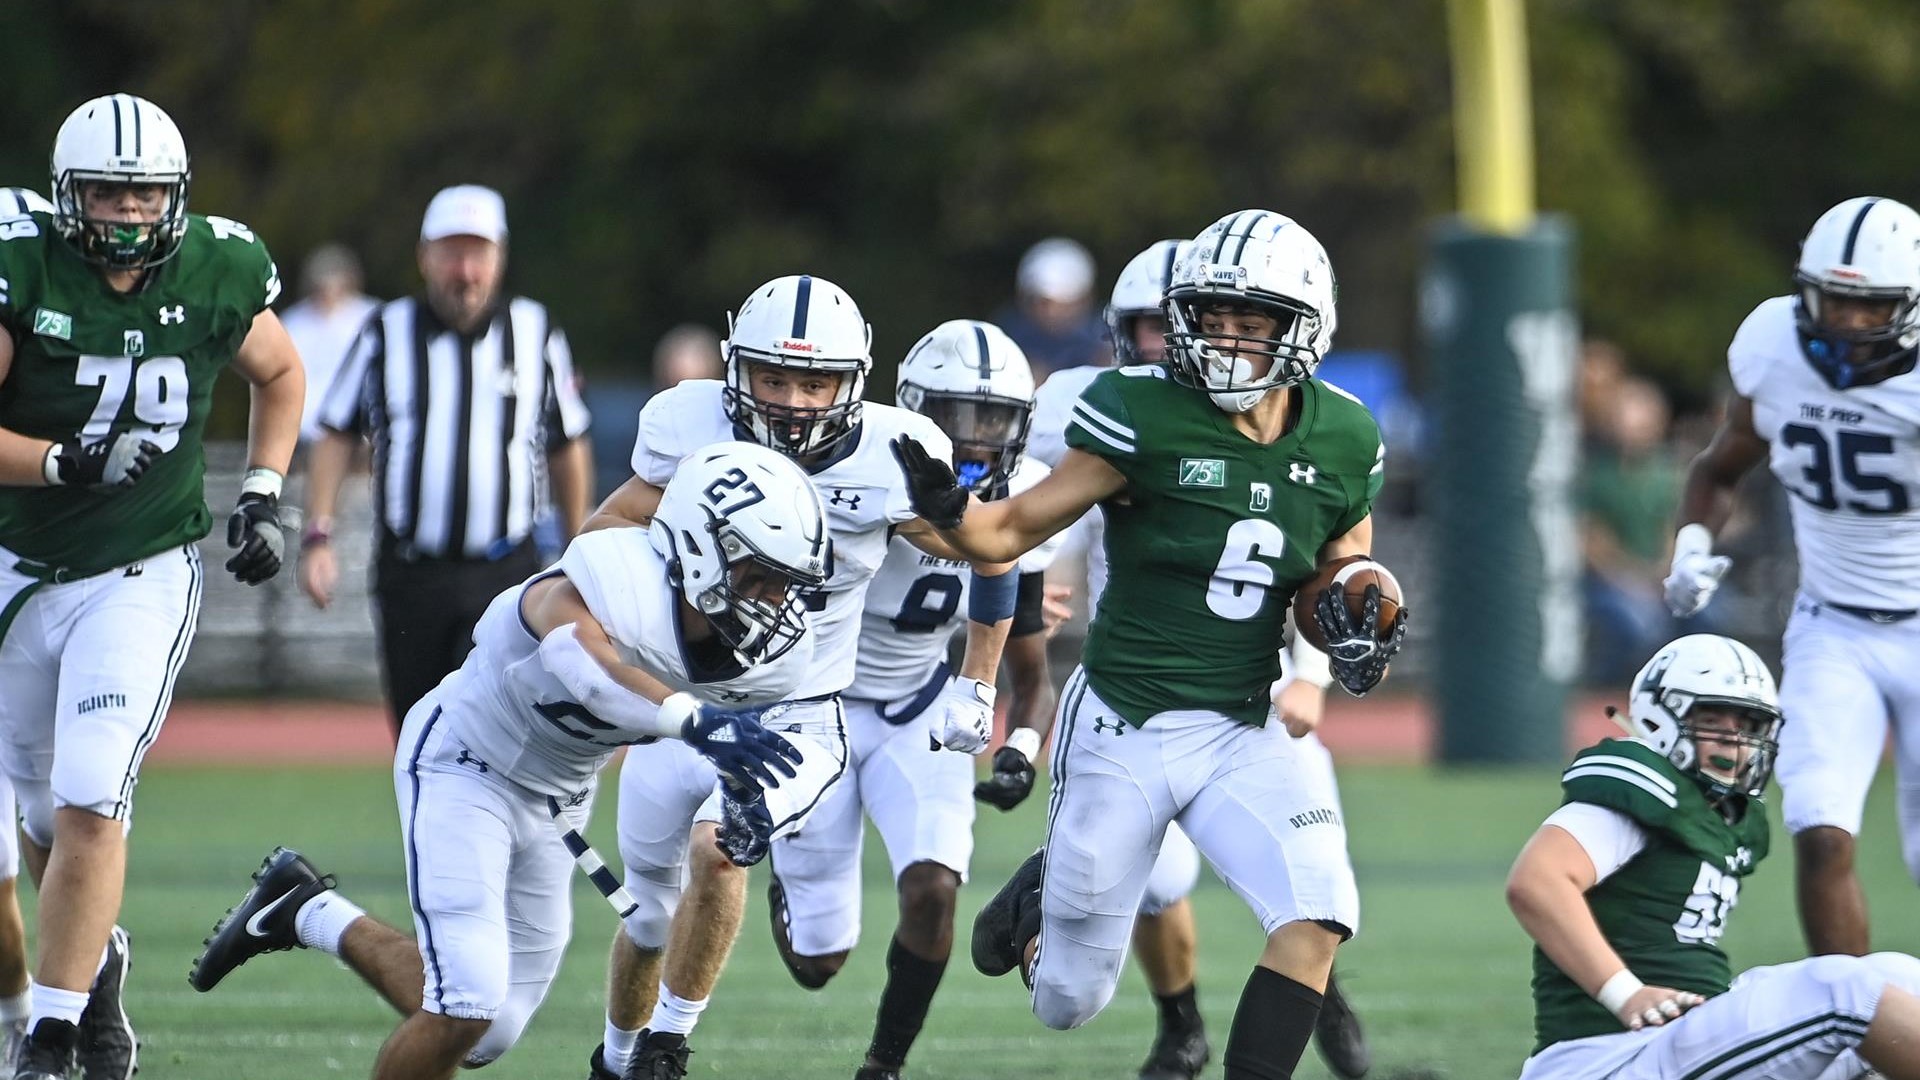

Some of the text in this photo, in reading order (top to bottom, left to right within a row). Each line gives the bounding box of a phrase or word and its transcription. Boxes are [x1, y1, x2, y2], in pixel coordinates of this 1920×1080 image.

[37, 310, 64, 336] 75
[783, 341, 812, 352] Riddell
[75, 355, 189, 454] 79
[1799, 403, 1825, 420] THE
[1182, 460, 1213, 484] 75
[1780, 422, 1909, 516] 35
[702, 467, 766, 519] 27
[1205, 518, 1284, 620] 6
